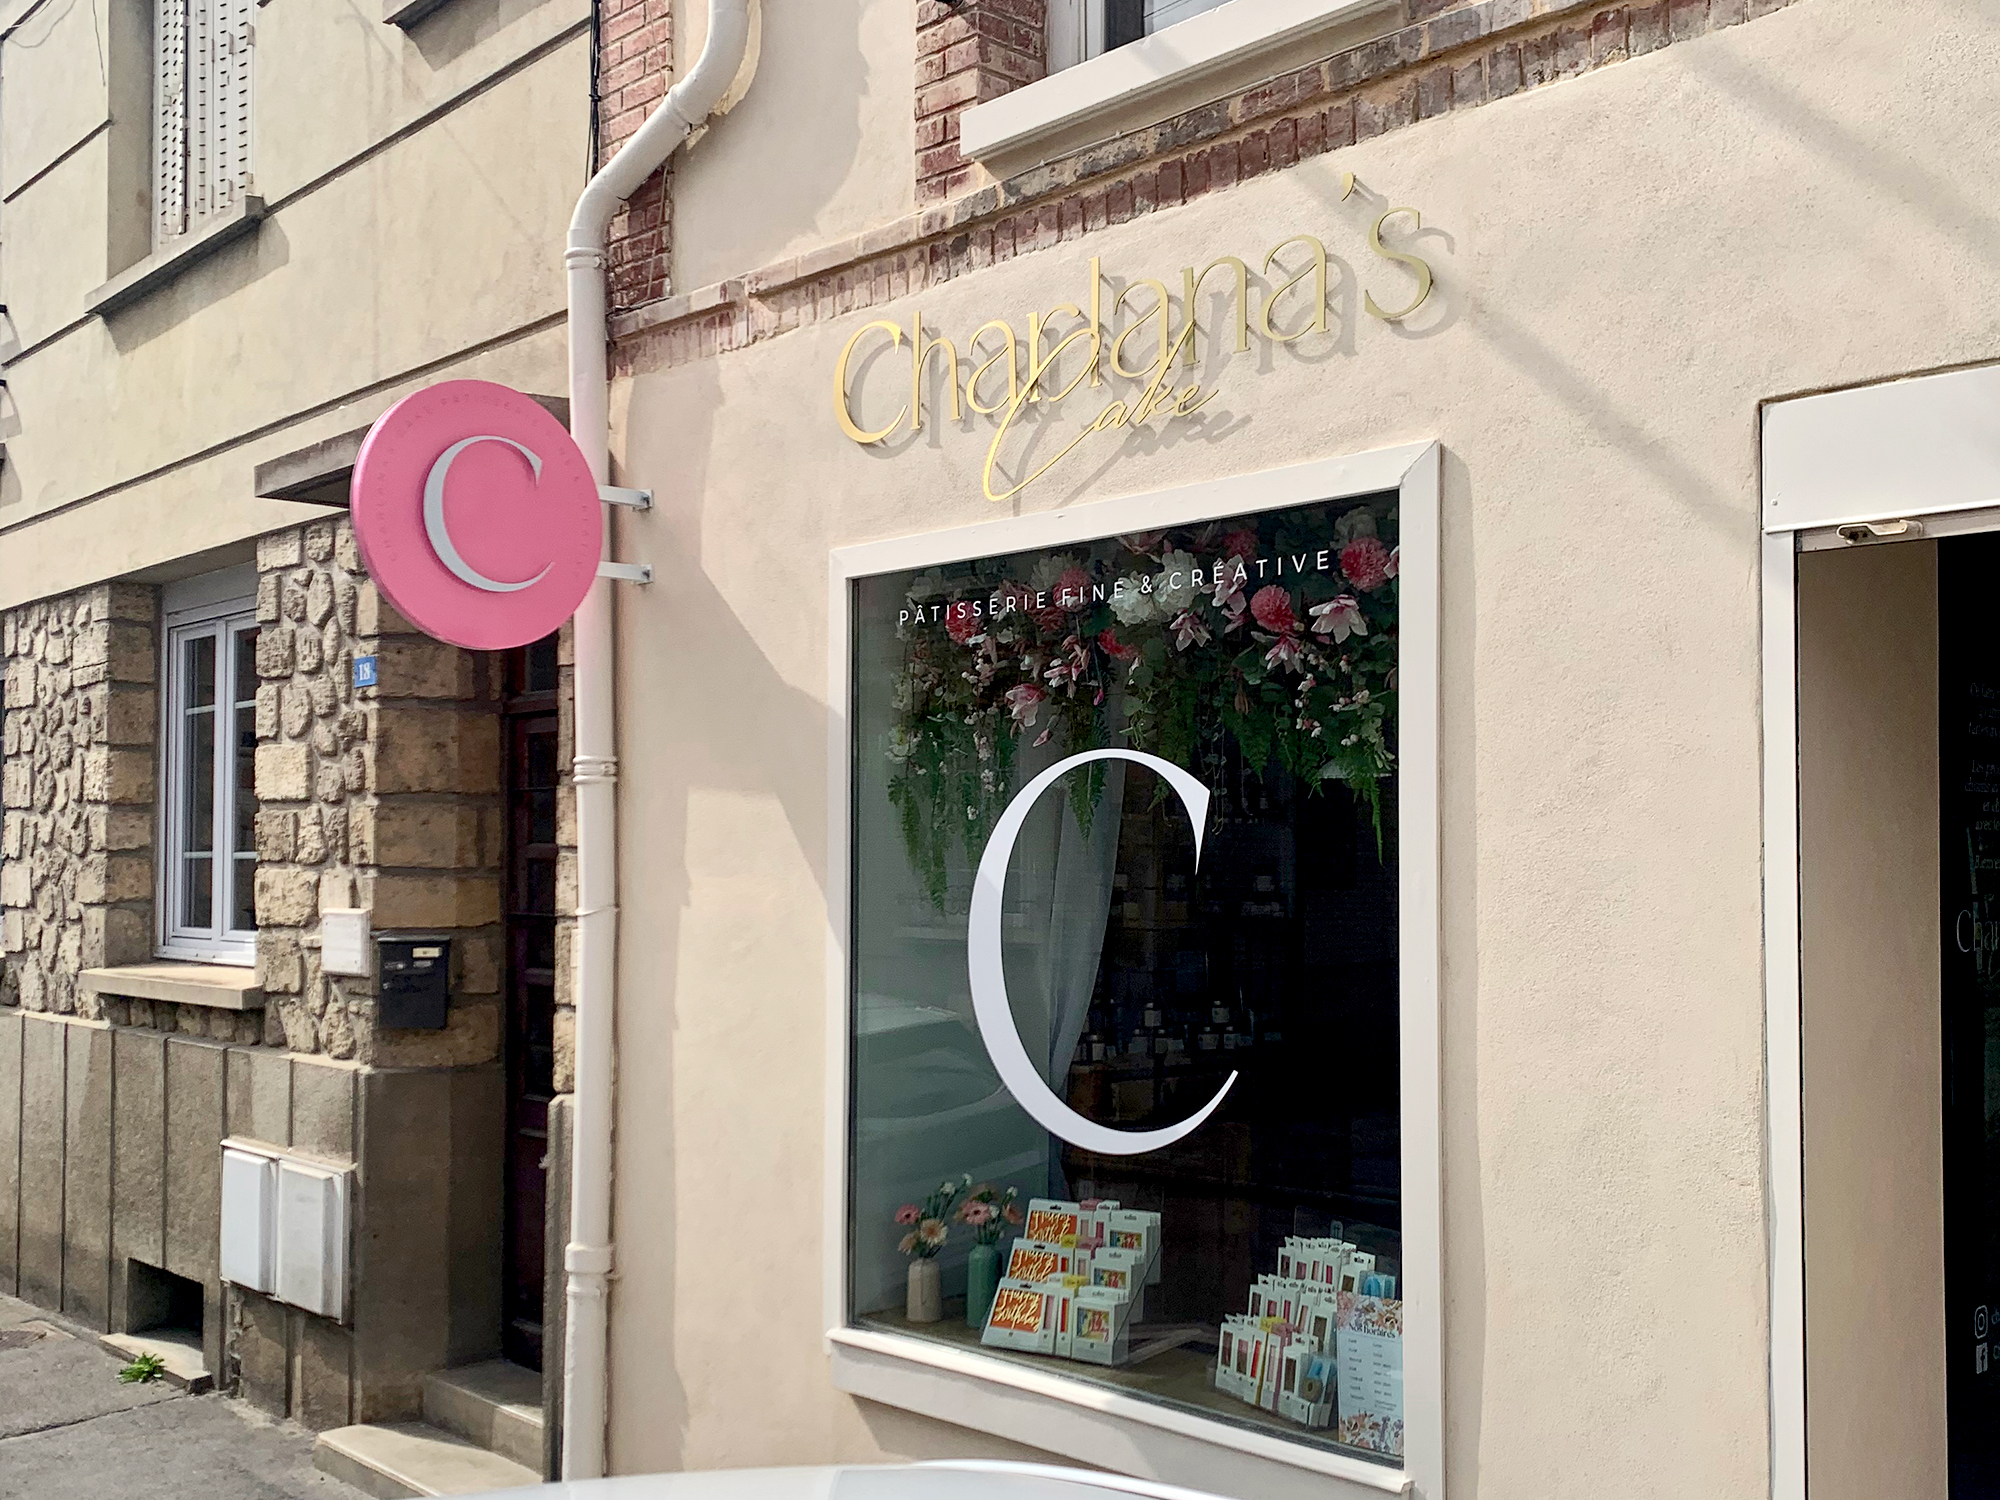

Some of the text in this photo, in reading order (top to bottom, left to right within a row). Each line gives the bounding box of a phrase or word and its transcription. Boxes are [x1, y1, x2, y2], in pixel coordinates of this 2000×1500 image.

[833, 171, 1433, 444] Charlana's
[982, 320, 1220, 502] Cake
[423, 434, 555, 592] C
[899, 549, 1330, 626] PÂTISSERIE FINE & CRÉATIVE
[358, 661, 371, 681] 18
[967, 748, 1239, 1156] C
